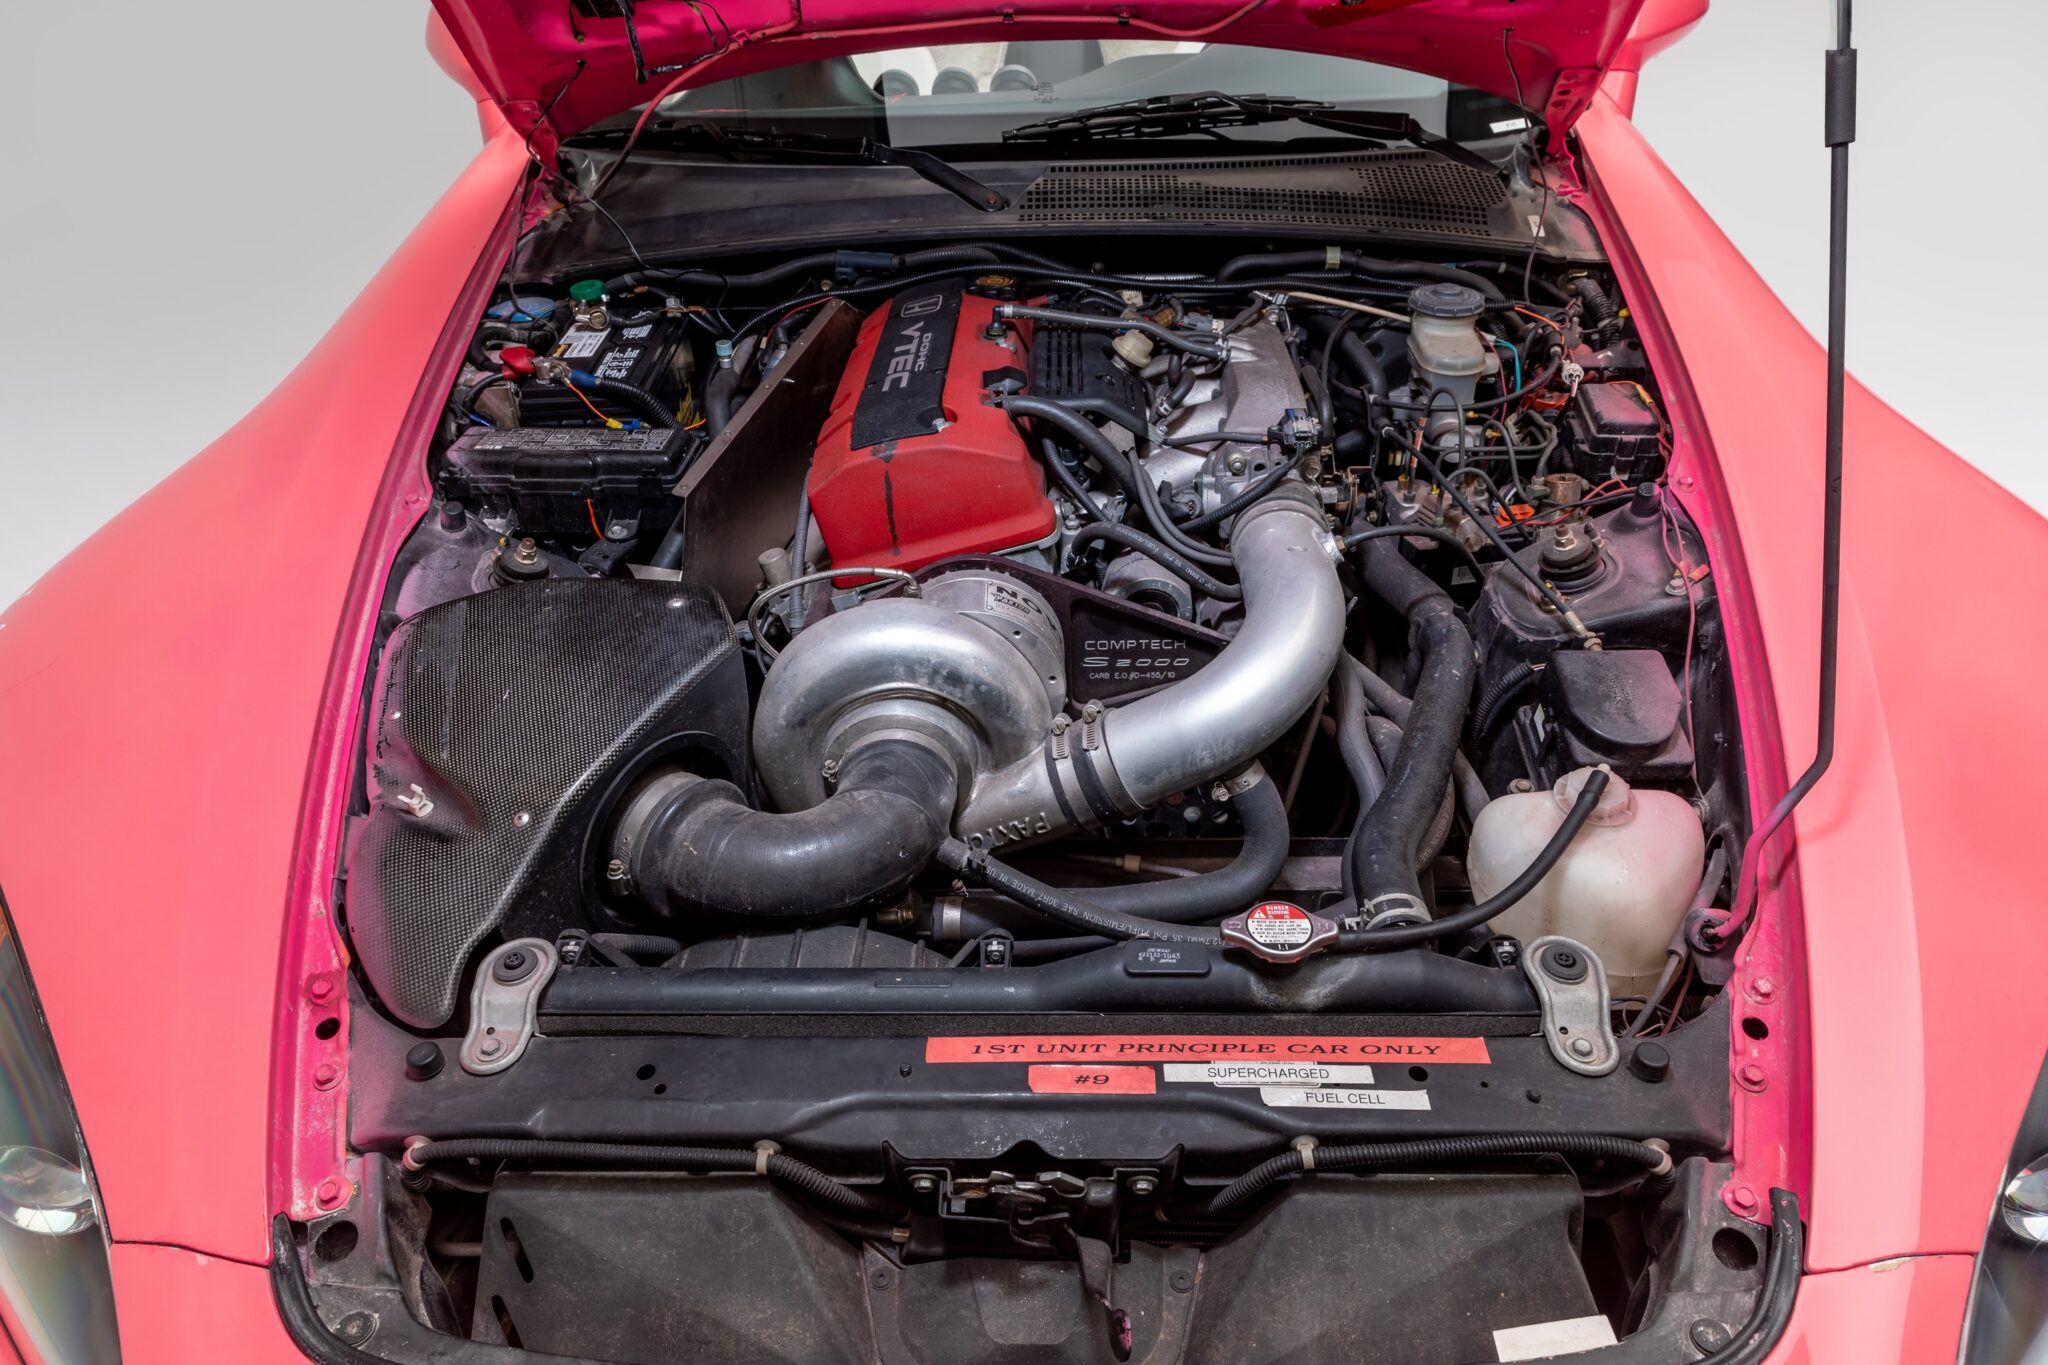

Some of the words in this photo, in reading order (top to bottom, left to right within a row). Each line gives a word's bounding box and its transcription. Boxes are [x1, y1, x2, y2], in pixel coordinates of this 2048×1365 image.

[882, 321, 924, 392] VTEC
[915, 332, 932, 372] DOHC
[1084, 639, 1186, 651] COMPTECH
[1089, 672, 1110, 680] CARB
[985, 865, 996, 877] US
[998, 872, 1008, 883] IN
[1011, 879, 1036, 897] MADE
[1038, 892, 1059, 907] 30R7
[1060, 902, 1080, 915] SAE
[1153, 930, 1168, 940] PSI
[970, 1043, 1024, 1056] 1ST
[1036, 1043, 1111, 1056] UNIT
[1118, 1043, 1276, 1054] PRINCIPLE
[1287, 1043, 1351, 1055] CAR
[1360, 1043, 1442, 1055] ONLY
[1207, 1066, 1330, 1079] SUPERCHARGED
[1074, 1073, 1110, 1086] #9
[1305, 1092, 1344, 1104] FUEL
[1347, 1093, 1386, 1106] CELL
